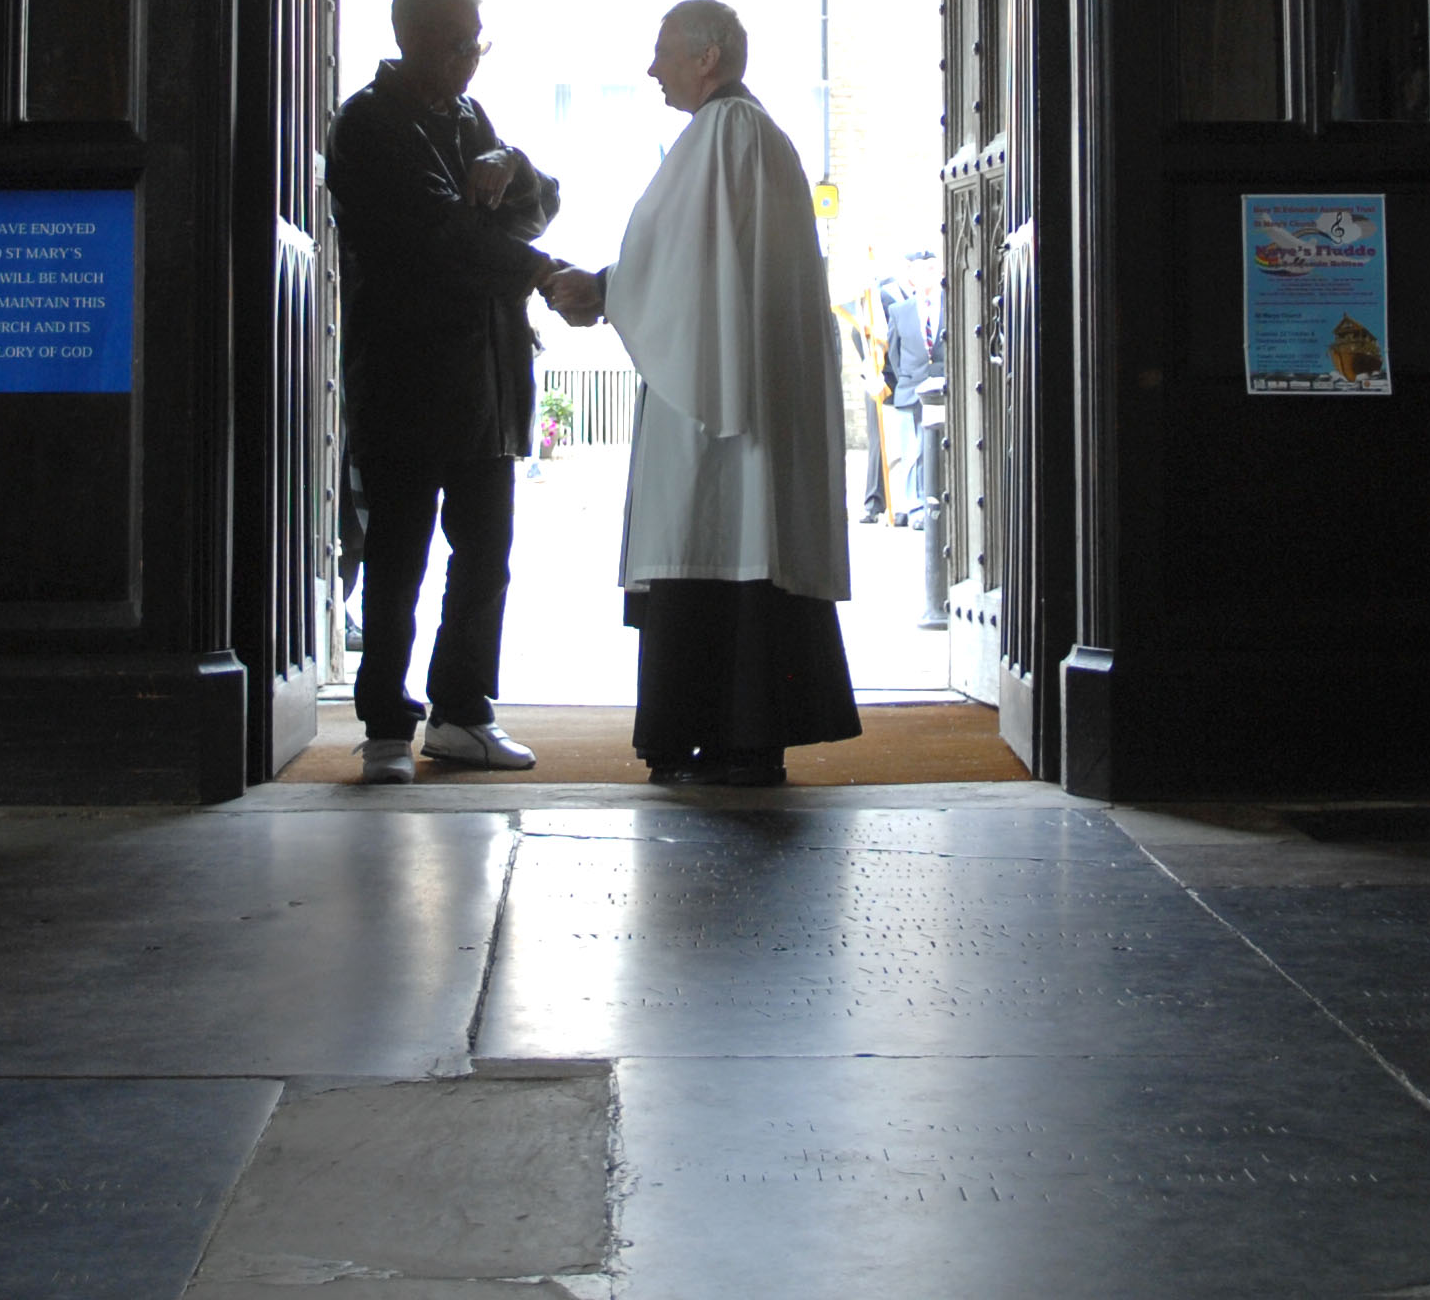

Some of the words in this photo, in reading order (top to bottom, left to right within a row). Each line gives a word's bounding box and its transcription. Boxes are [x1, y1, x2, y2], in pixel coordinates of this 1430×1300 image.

[31, 223, 96, 236] ENJOYED
[6, 248, 23, 260] ST
[26, 248, 82, 260] MARY'S
[0, 272, 35, 285] WILL
[39, 272, 57, 285] BE
[61, 272, 104, 285] MUCH
[73, 297, 106, 309] THIS
[34, 321, 65, 334] AND
[69, 321, 90, 334] ITS
[39, 346, 58, 359] OF
[62, 346, 93, 359] GOD
